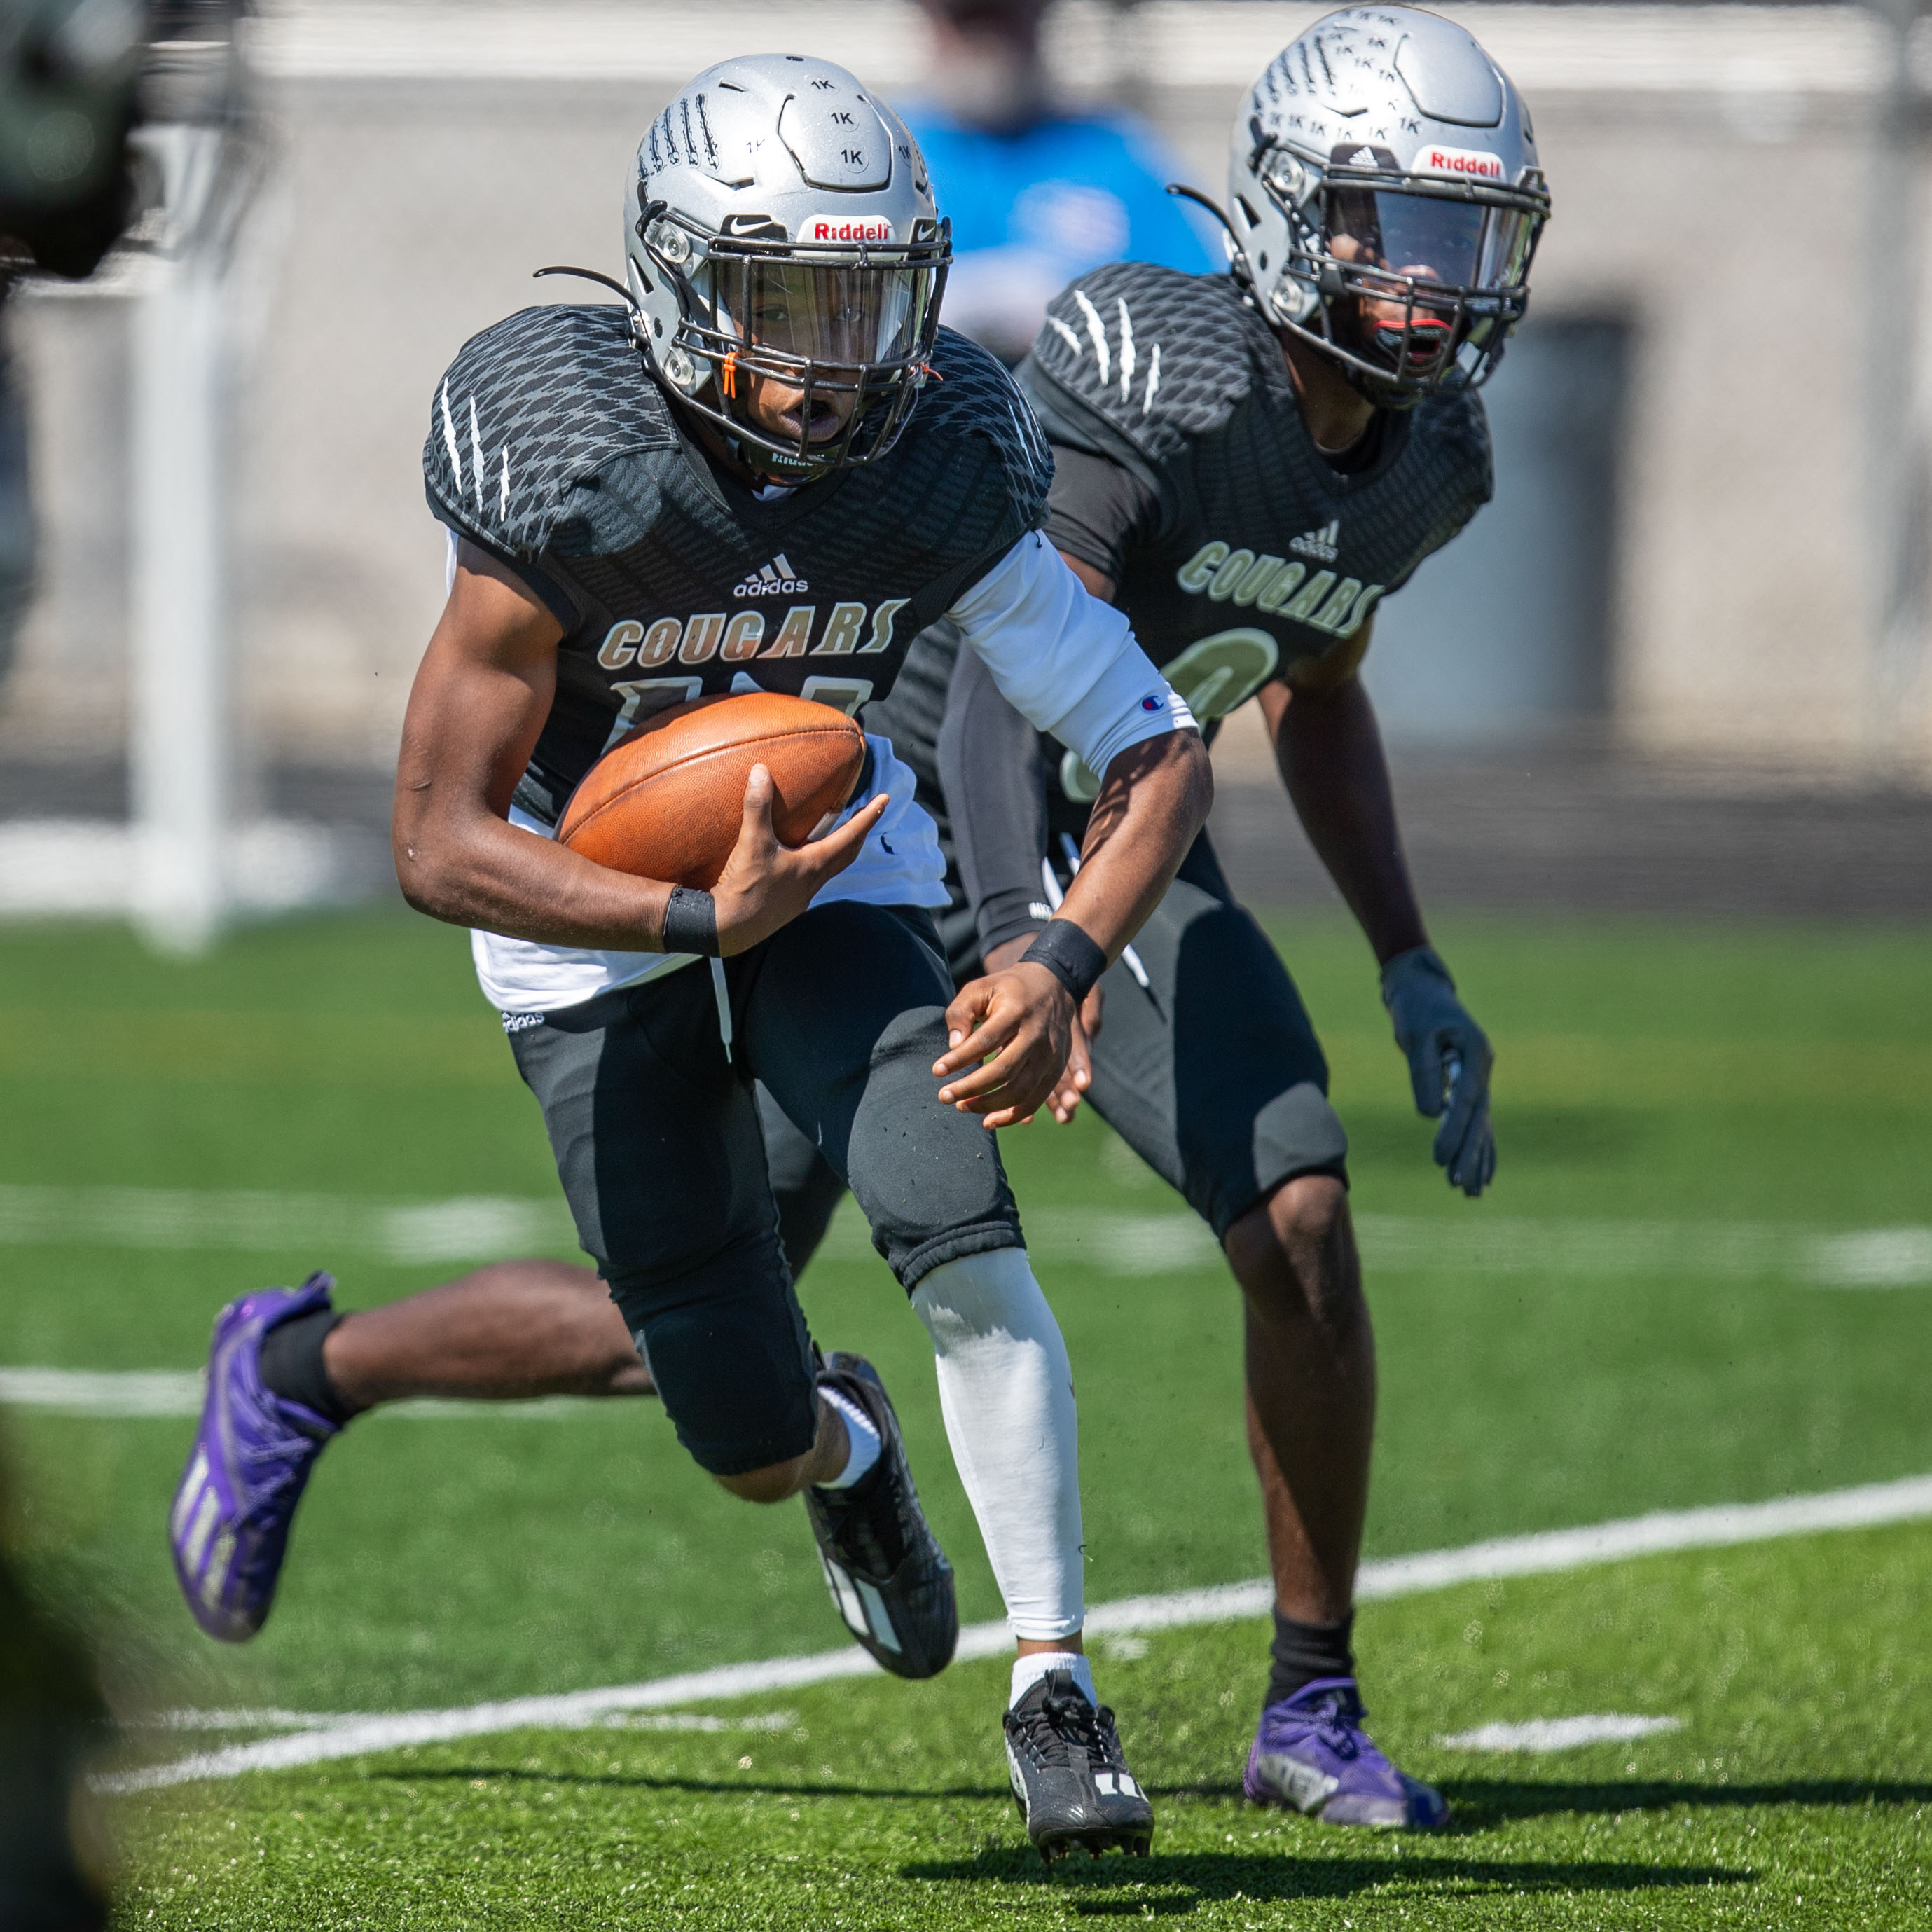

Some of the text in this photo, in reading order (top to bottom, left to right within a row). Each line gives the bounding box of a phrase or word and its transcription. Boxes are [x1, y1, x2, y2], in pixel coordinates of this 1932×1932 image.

[812, 79, 835, 90] 1K
[831, 112, 854, 125] 1K
[1400, 116, 1422, 134] 1K
[841, 149, 863, 165] 1K
[898, 145, 912, 160] 1K
[1430, 151, 1500, 177] Riddell
[814, 223, 889, 240] Riddell
[733, 578, 809, 598] adidas
[1176, 541, 1385, 640] COUGARS
[596, 598, 912, 670] COUGARS
